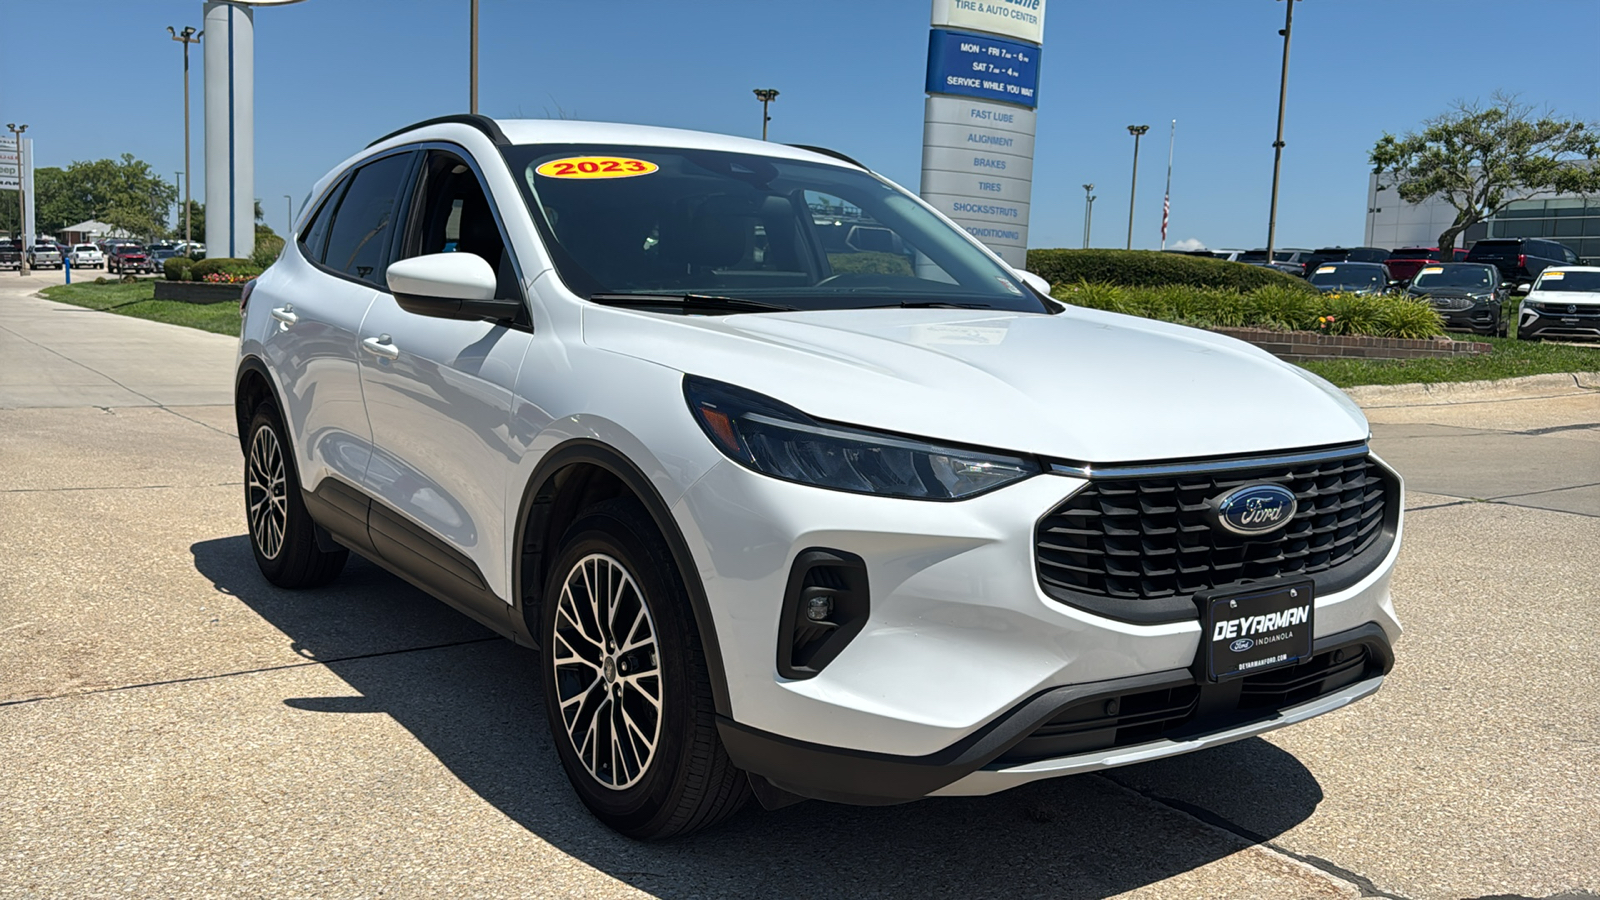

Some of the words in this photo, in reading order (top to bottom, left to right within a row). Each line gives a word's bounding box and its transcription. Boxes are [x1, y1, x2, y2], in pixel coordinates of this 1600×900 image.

[955, 0, 977, 11] TIRE
[978, 3, 984, 12] &
[986, 5, 1009, 17] AUTO
[1010, 9, 1038, 25] CENTER
[1005, 0, 1040, 10] ane
[960, 42, 979, 54] MON
[988, 47, 1000, 57] FRI
[972, 61, 987, 71] SAT
[946, 76, 981, 88] SERVICE
[983, 80, 1005, 92] WHILE
[1006, 84, 1019, 95] YOU
[1020, 87, 1034, 98] WAIT
[970, 108, 992, 120] FAST
[993, 112, 1014, 124] LUBE
[967, 133, 1014, 147] ALIGNMENT
[553, 161, 648, 175] 2023
[973, 157, 1006, 170] BRAKES
[978, 181, 1002, 192] TIRES
[953, 202, 1018, 218] SHOCKS/STRUTS
[966, 227, 1019, 240] CONDITIONING
[1241, 496, 1283, 525] Ford
[1212, 605, 1310, 642] DEYARMAN
[1255, 631, 1294, 646] INDIANOLA
[1238, 653, 1288, 670] DEYARMANFORD.COM
